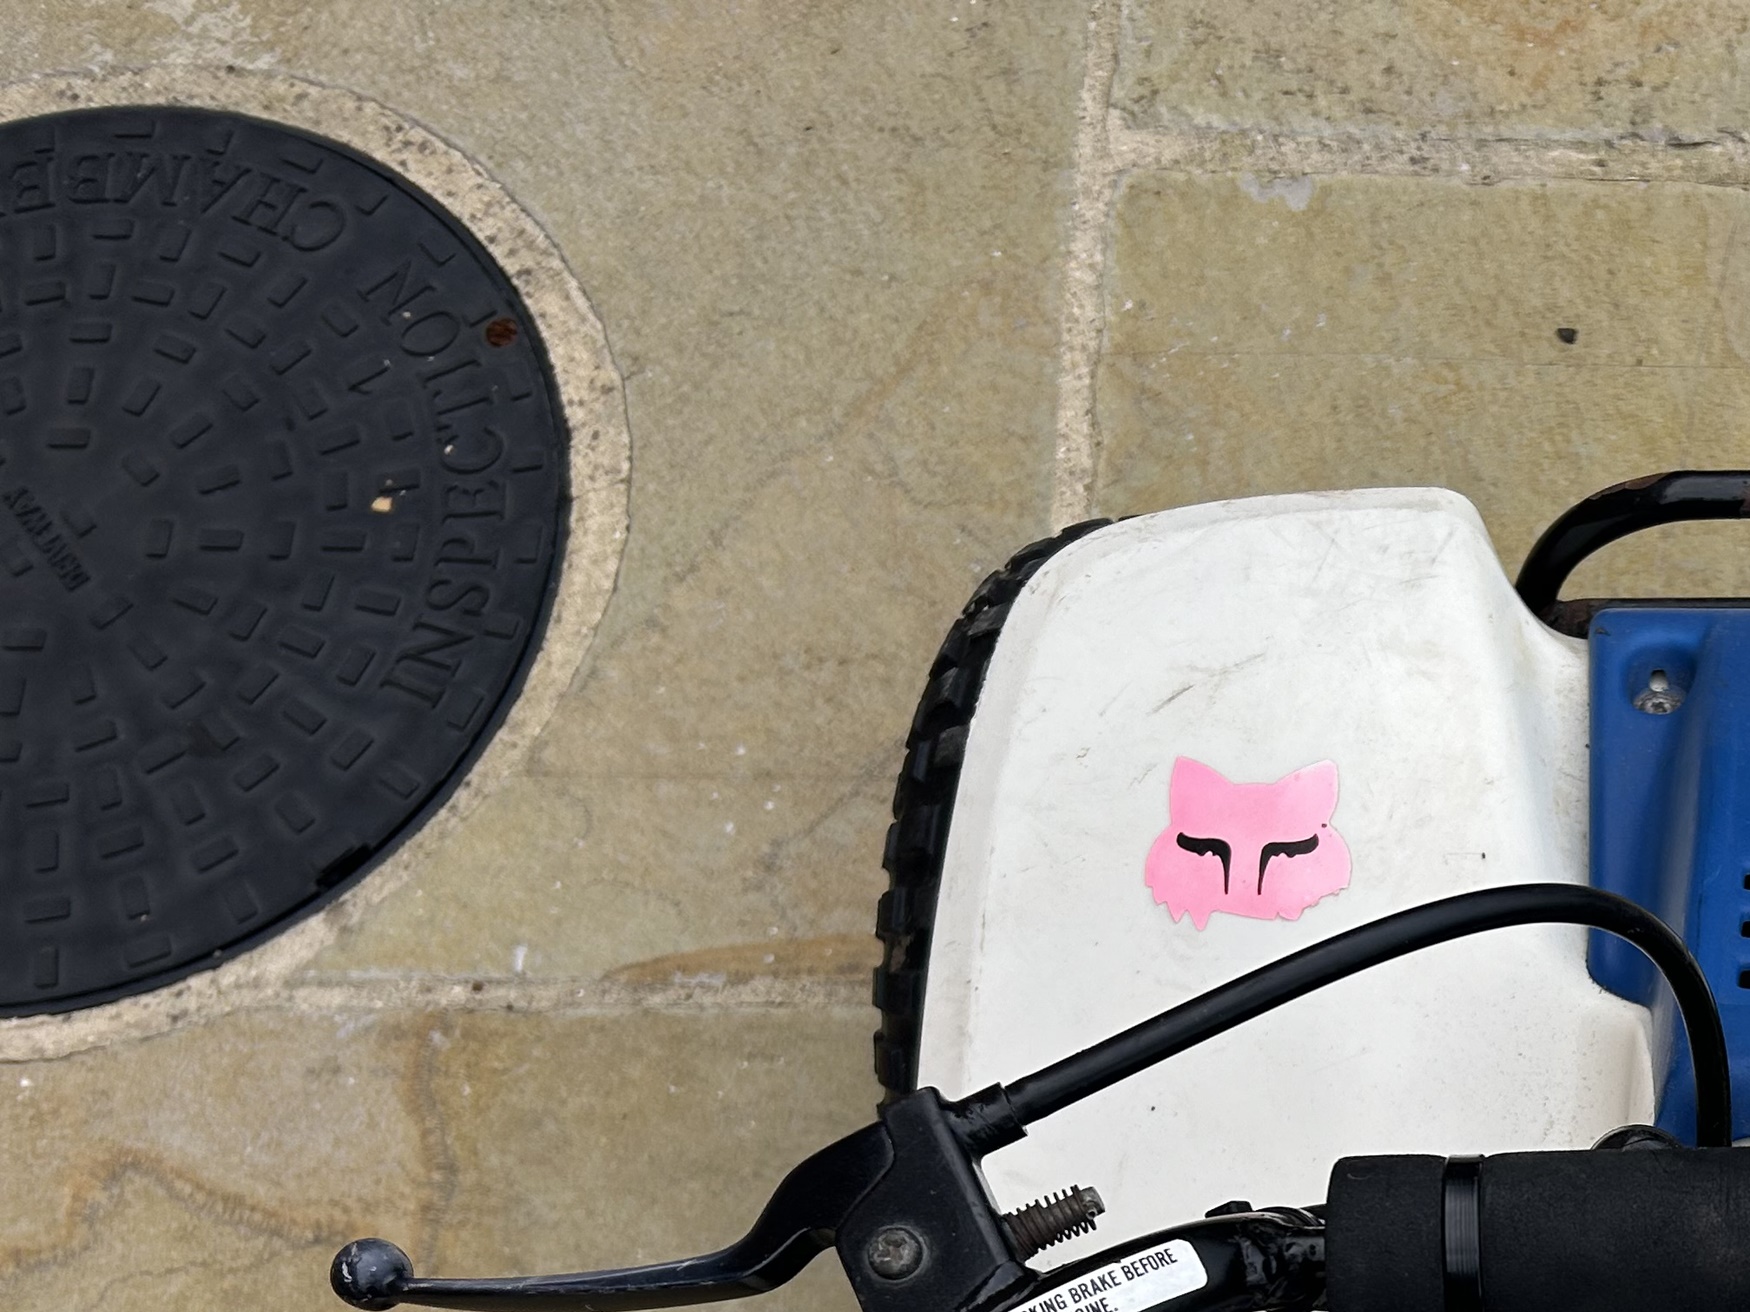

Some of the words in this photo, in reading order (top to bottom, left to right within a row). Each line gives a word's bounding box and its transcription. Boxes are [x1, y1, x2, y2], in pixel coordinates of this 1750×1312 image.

[0, 150, 346, 253] CHAMBE
[357, 256, 507, 709] INSPECTION
[1068, 1269, 1122, 1304] BRAKE
[1120, 1247, 1179, 1282] BEFORE
